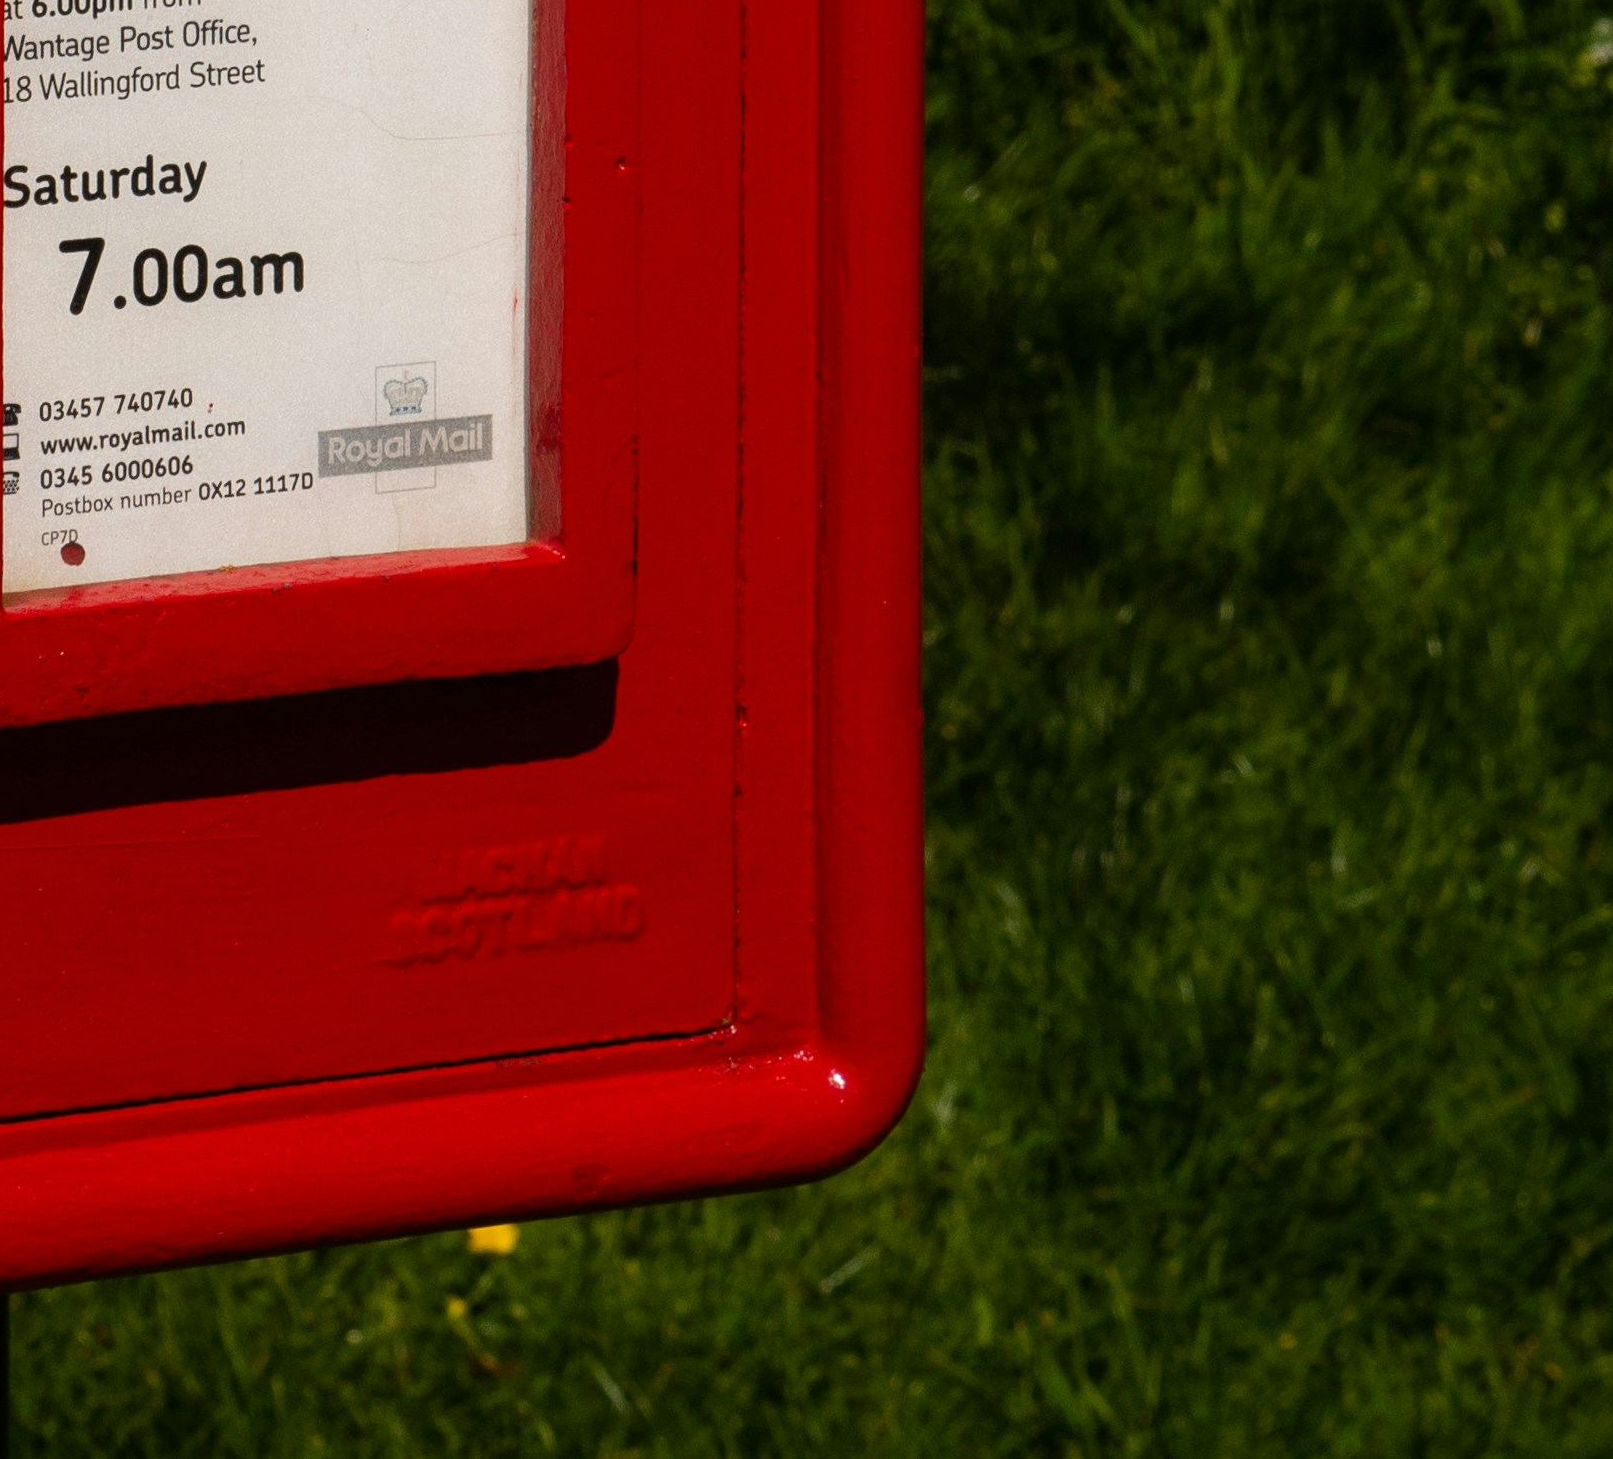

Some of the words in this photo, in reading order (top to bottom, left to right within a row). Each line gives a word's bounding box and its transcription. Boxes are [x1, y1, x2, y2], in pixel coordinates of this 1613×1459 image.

[121, 26, 174, 52] Post
[183, 19, 256, 47] Office,
[4, 76, 32, 103] 18
[39, 64, 180, 100] Wallingford
[190, 60, 265, 88] Street
[4, 154, 207, 208] Saturday
[59, 237, 303, 315] 7.00am
[40, 397, 105, 421] 03457
[114, 388, 192, 414] 740740
[41, 421, 245, 455] www.royalmail.com
[328, 427, 412, 467] Royal
[419, 421, 484, 457] Mail
[41, 465, 92, 489] 0345
[102, 455, 193, 483] 6000606
[43, 496, 113, 517] Postbox
[121, 487, 191, 508] number
[254, 472, 313, 494] 1117D
